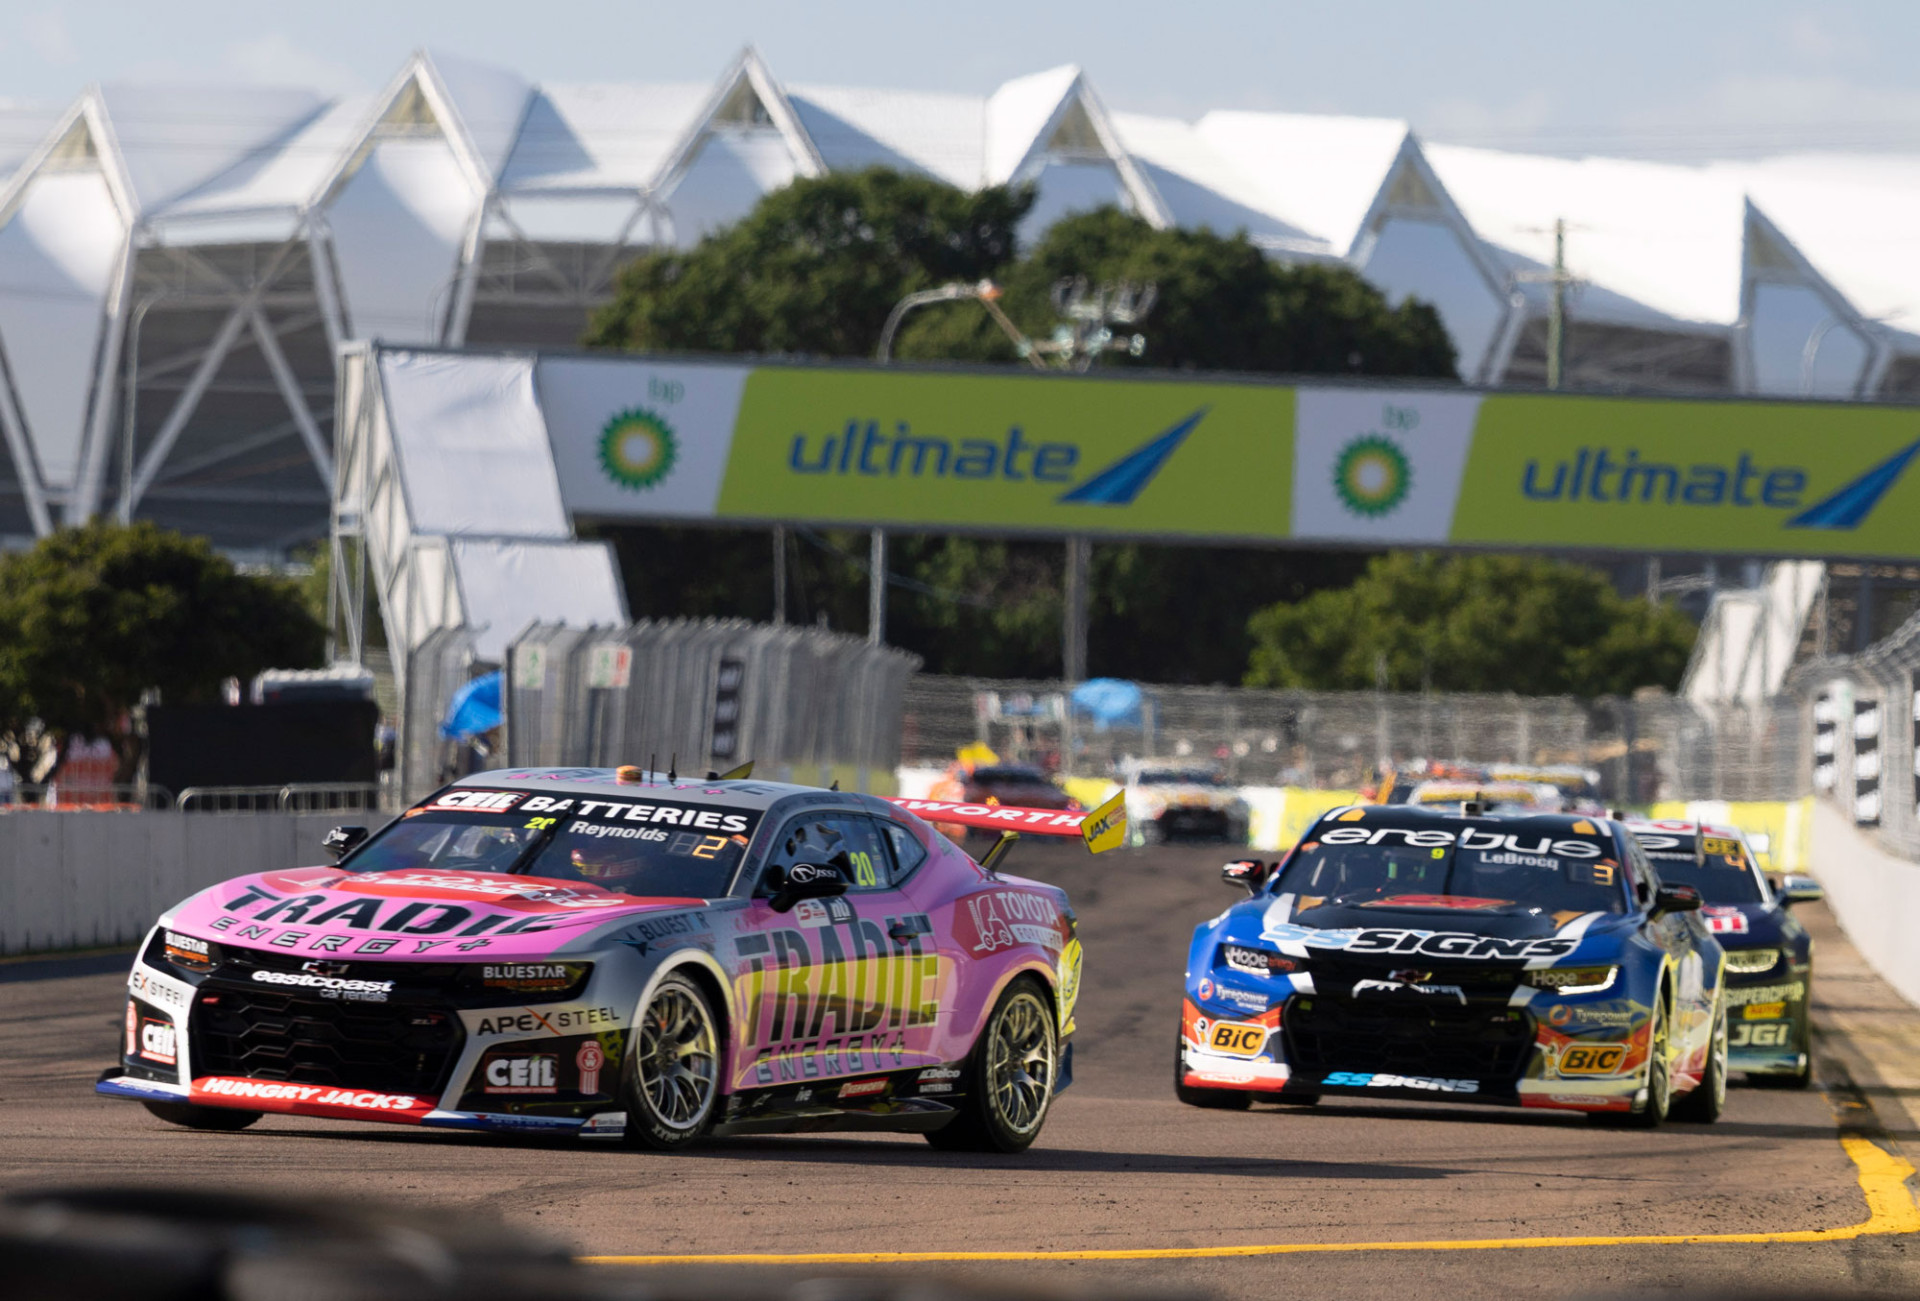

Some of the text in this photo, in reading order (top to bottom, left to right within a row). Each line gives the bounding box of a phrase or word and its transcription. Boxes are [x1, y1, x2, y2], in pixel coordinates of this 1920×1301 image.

[788, 419, 1080, 482] ultimate
[1521, 447, 1808, 507] ultimate
[520, 796, 748, 832] BATTERIES
[893, 800, 1087, 827] WORTH
[569, 821, 668, 842] Reynolds
[1088, 814, 1111, 842] JAX
[1320, 827, 1602, 859] erebus
[1431, 848, 1445, 859] 9
[850, 851, 876, 886] 20
[1480, 852, 1559, 871] LeBrocq
[223, 884, 585, 937] TRADIE
[996, 892, 1060, 927] TOYOTA
[1229, 945, 1269, 968] Hope
[252, 969, 396, 993] eastcoast
[483, 966, 566, 978] BLUESTAR
[733, 913, 938, 1049] TRADIE
[320, 989, 387, 1002] car rentals
[1216, 984, 1269, 1004] Tyrepower
[478, 1007, 620, 1035] APEX STEEL
[1728, 1024, 1790, 1046] JGI
[486, 1056, 556, 1086] CEIL
[202, 1077, 416, 1110] HUNGRY JACKS
